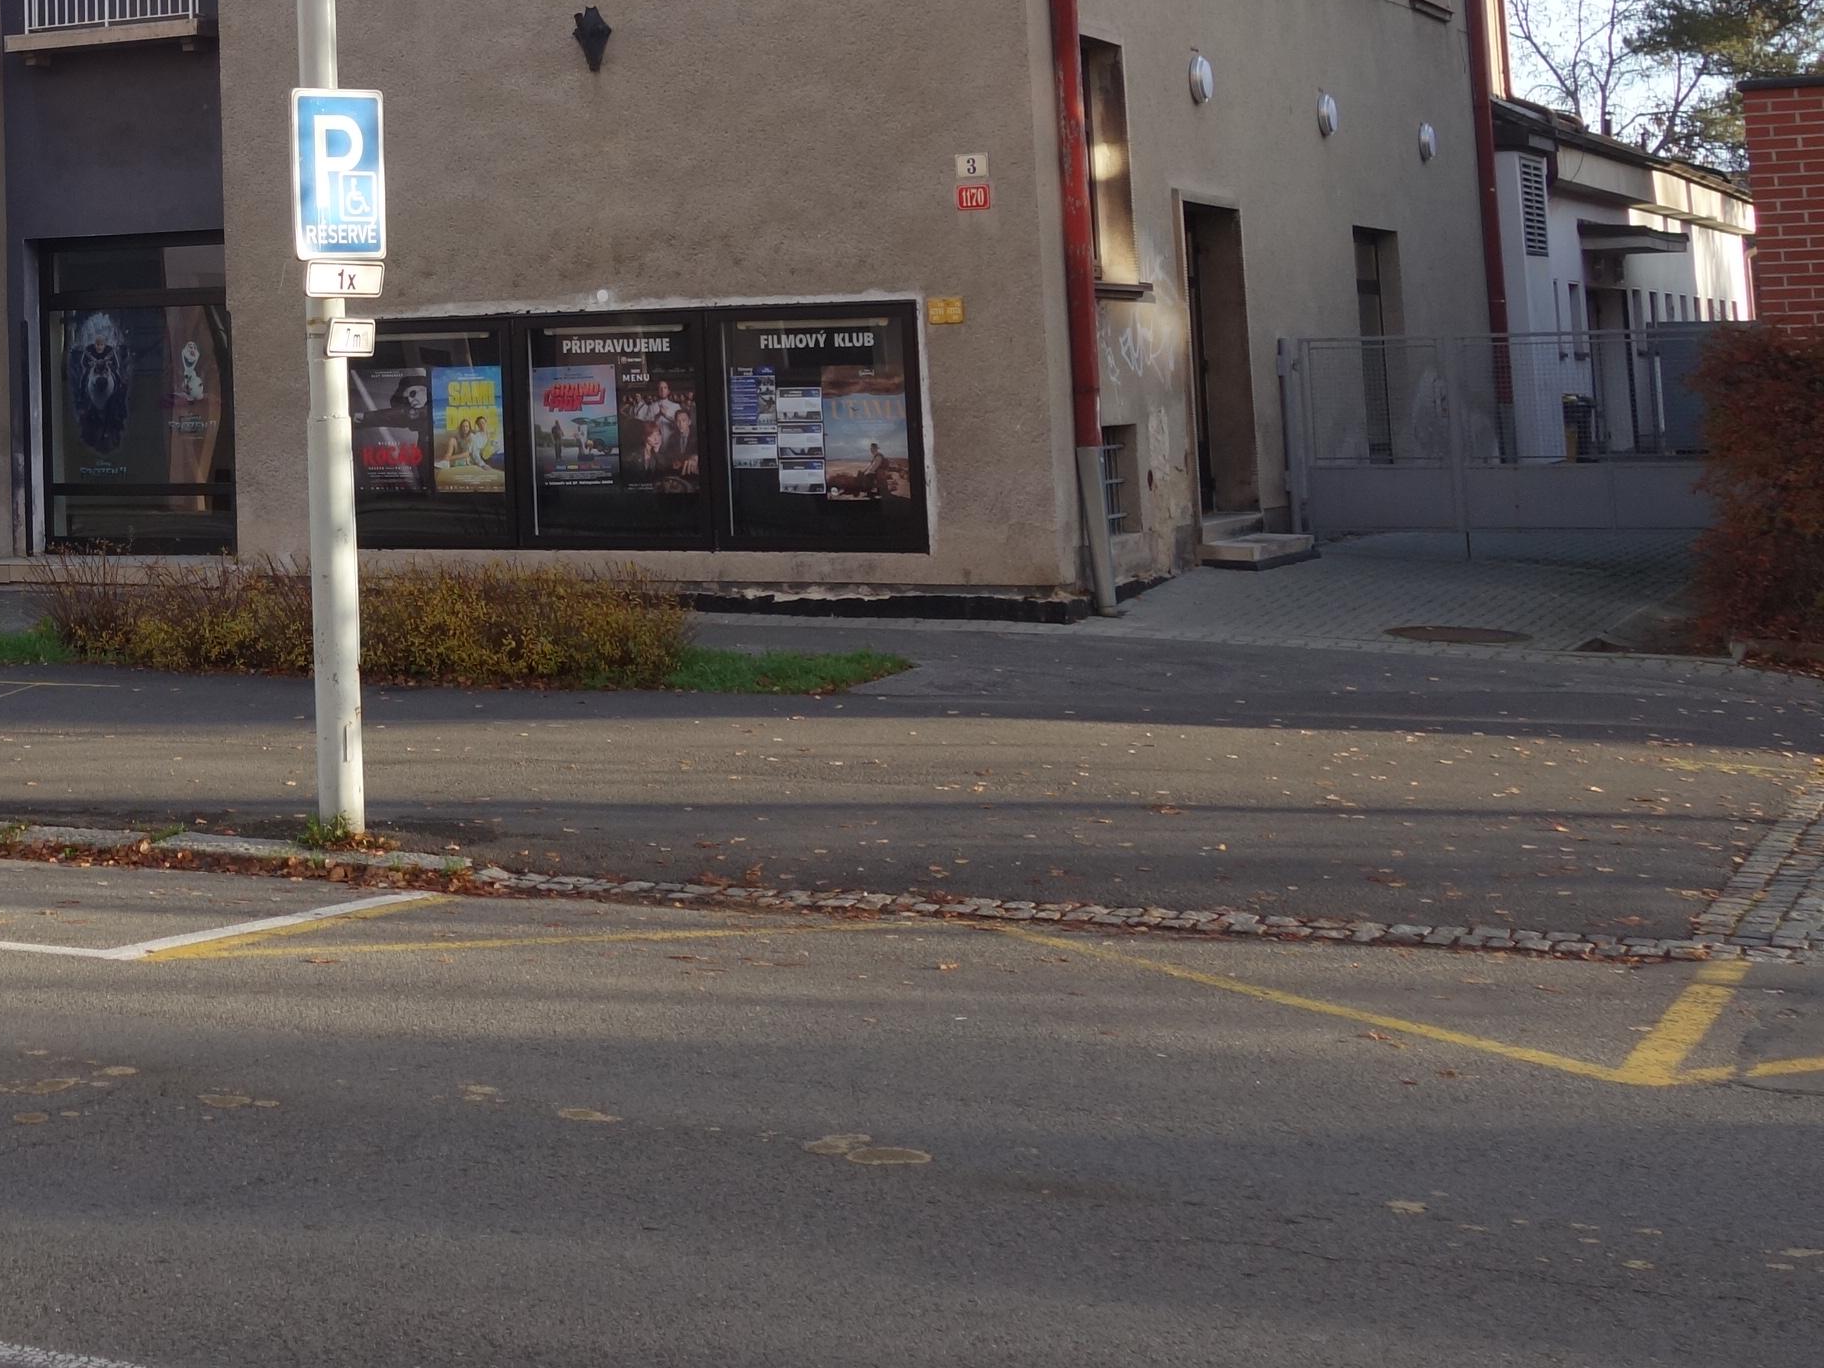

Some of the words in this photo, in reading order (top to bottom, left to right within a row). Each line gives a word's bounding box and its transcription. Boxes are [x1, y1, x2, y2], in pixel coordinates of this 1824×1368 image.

[314, 114, 363, 208] P
[967, 158, 976, 174] 3
[961, 189, 984, 206] 1170
[337, 269, 356, 290] 1x
[563, 337, 671, 353] PŘIPRAVUJEME
[760, 331, 826, 349] FILMOVÝ
[834, 332, 874, 347] KLUB
[623, 373, 650, 382] MENU
